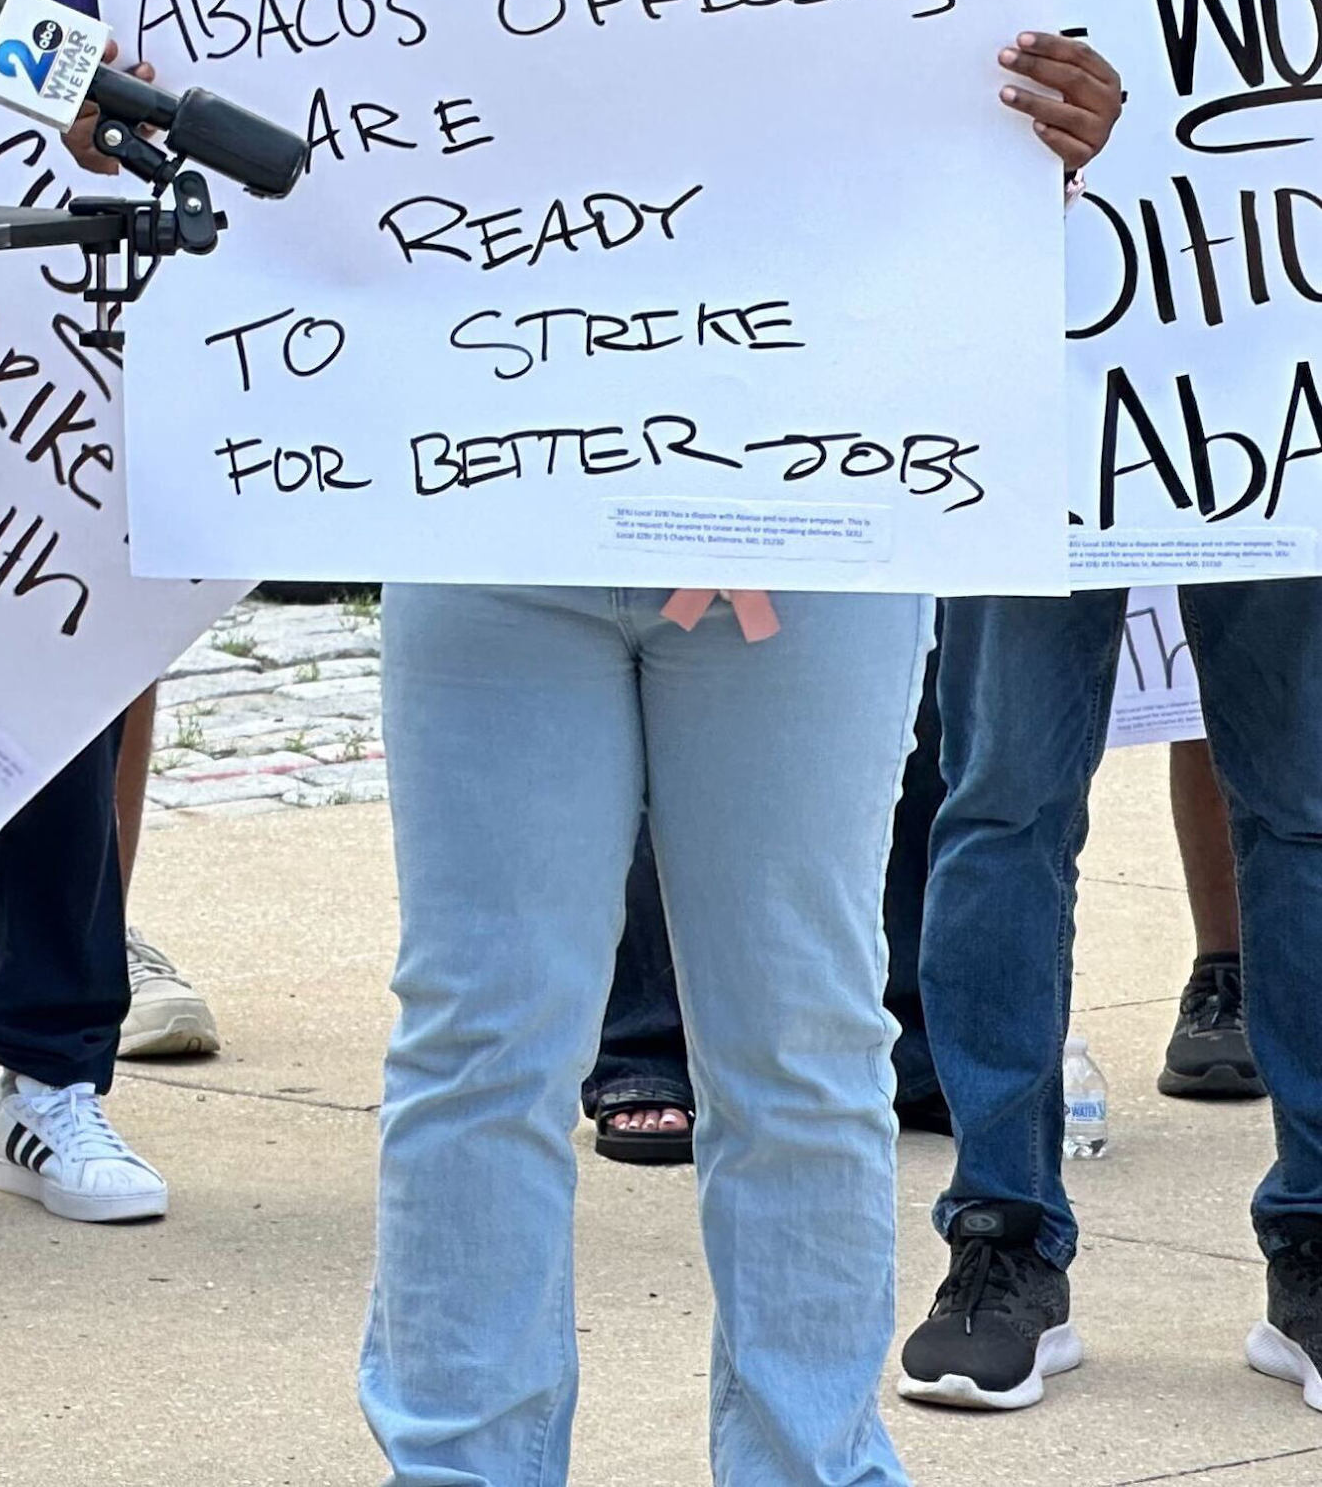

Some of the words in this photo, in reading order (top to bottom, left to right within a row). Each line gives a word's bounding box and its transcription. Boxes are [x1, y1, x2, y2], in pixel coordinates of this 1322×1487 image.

[39, 21, 57, 50] abc
[44, 29, 88, 101] WMAR
[63, 43, 98, 104] NEWS
[304, 87, 495, 177] ARE
[378, 182, 705, 272] READY
[205, 306, 346, 393] TO
[449, 299, 806, 383] STRIKE
[214, 433, 372, 499] FOR
